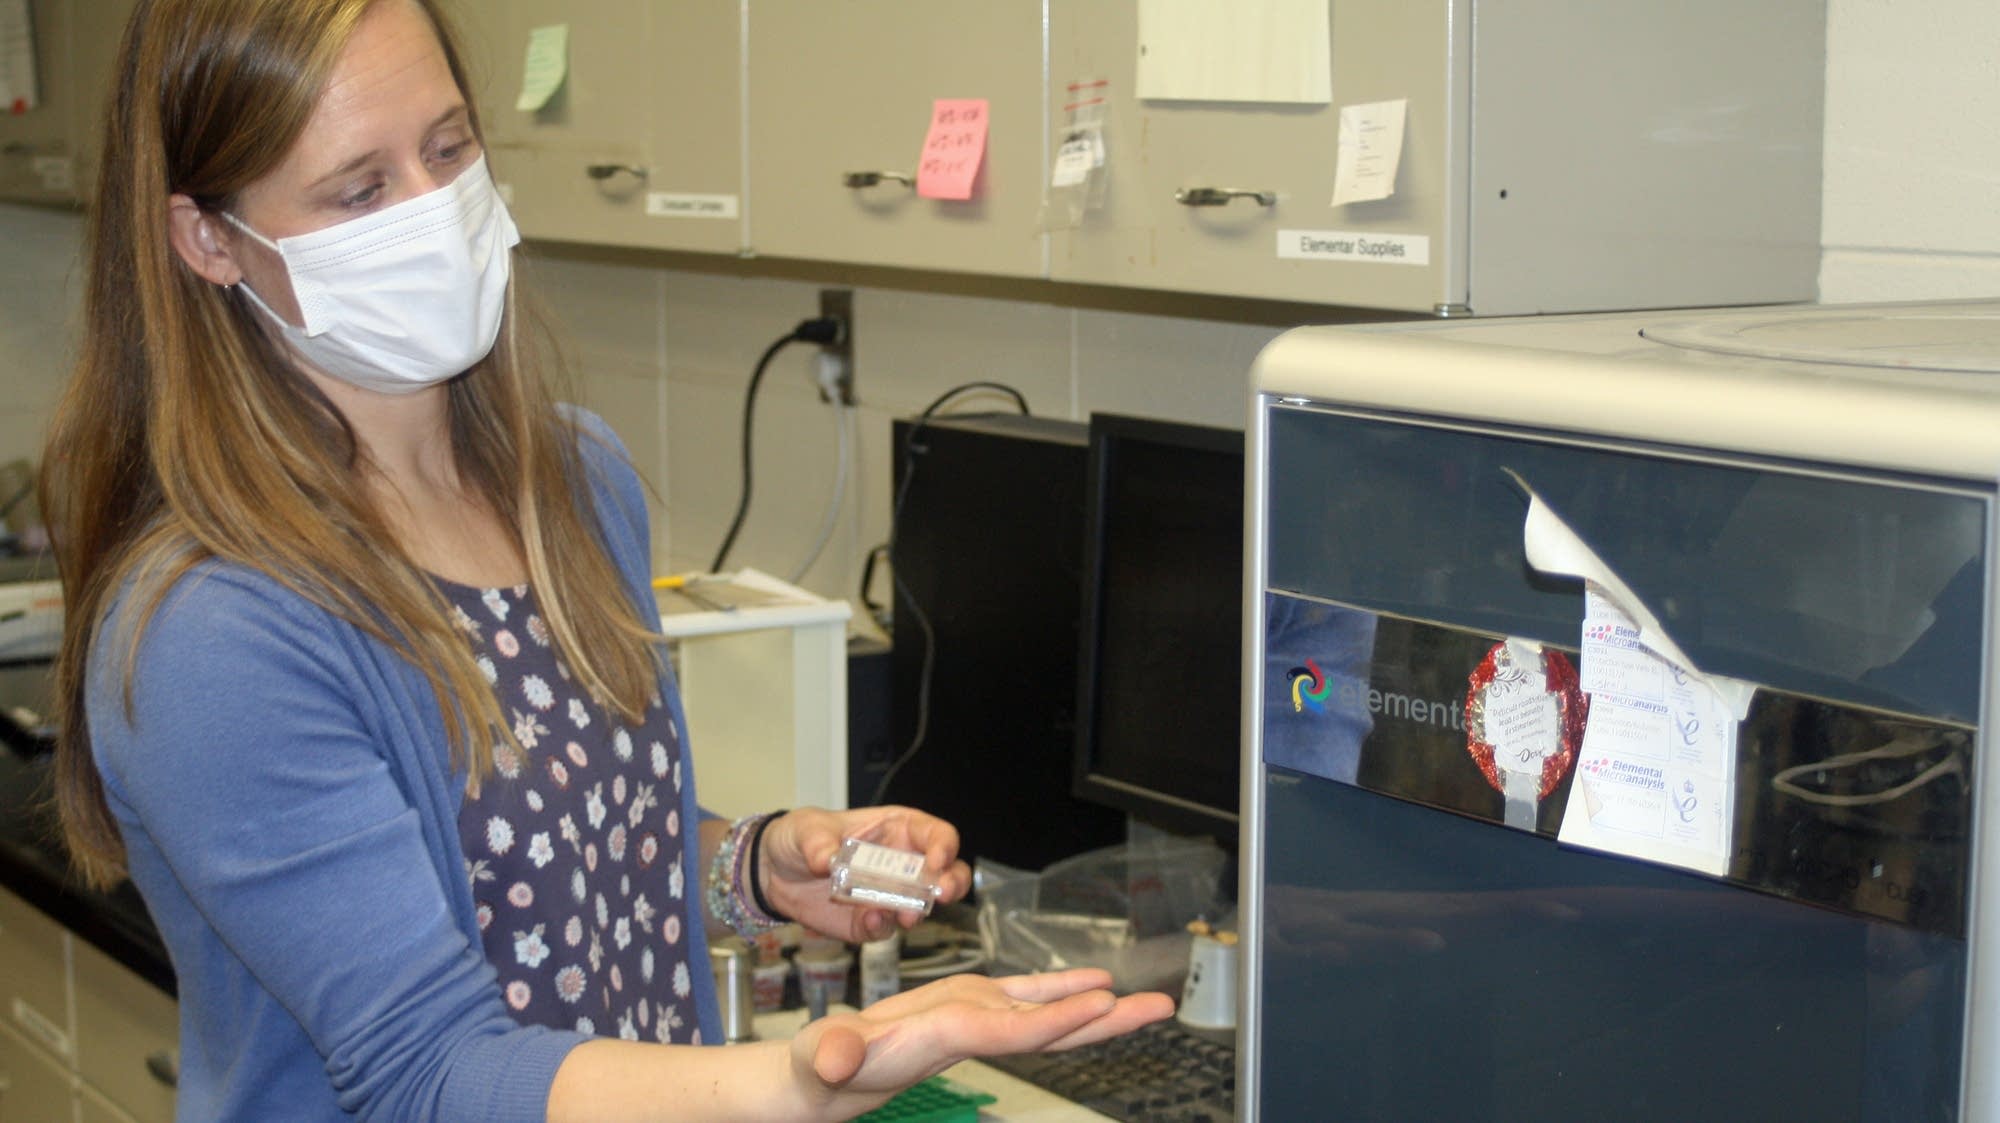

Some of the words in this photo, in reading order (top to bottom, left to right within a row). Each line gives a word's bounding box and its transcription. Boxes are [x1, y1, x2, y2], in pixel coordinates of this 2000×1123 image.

[1300, 236, 1355, 254] Elementar
[1358, 238, 1406, 257] Supplies
[1614, 625, 1641, 640] Eleme
[1340, 679, 1469, 732] element
[1516, 747, 1544, 763] Dove
[1611, 759, 1663, 778] Elemental
[1598, 768, 1665, 790] Microanalysis
